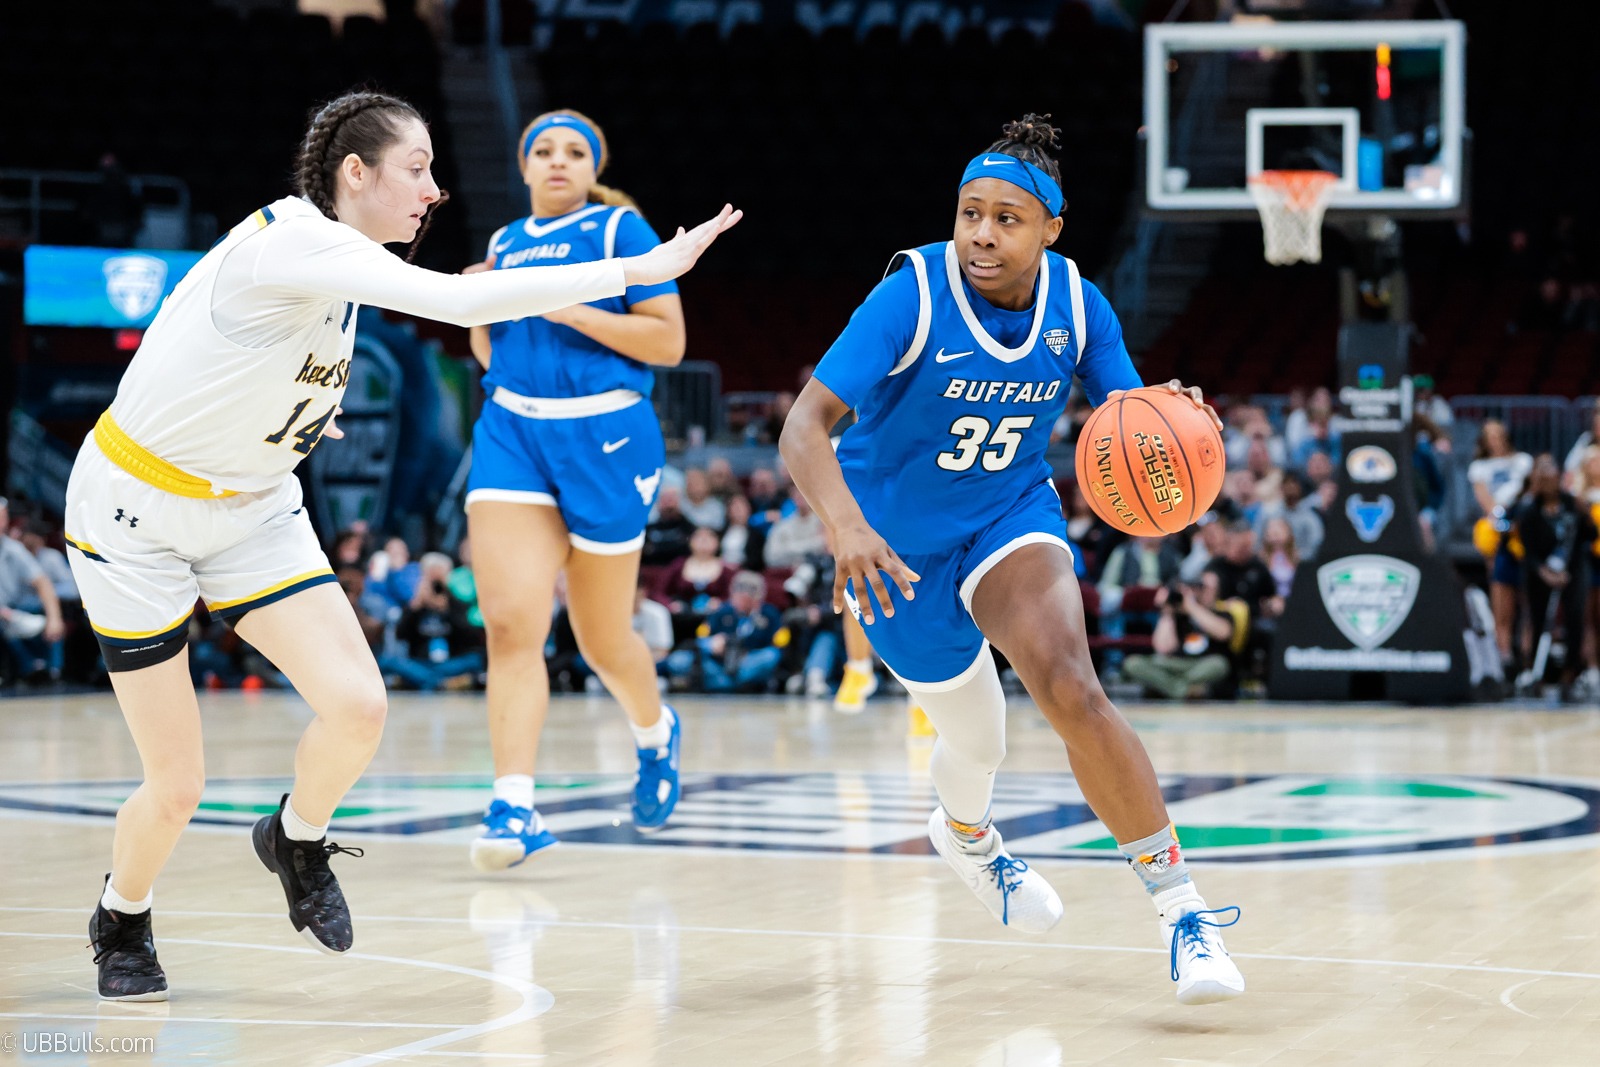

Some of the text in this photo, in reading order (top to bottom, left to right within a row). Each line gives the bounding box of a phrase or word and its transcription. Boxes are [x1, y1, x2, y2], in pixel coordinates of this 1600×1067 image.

[1046, 336, 1069, 346] MAC
[940, 377, 1061, 403] BUFFALO
[262, 397, 338, 456] 14
[936, 414, 1036, 472] 35
[1095, 435, 1143, 526] SPALDING
[1133, 431, 1174, 515] LEGACY
